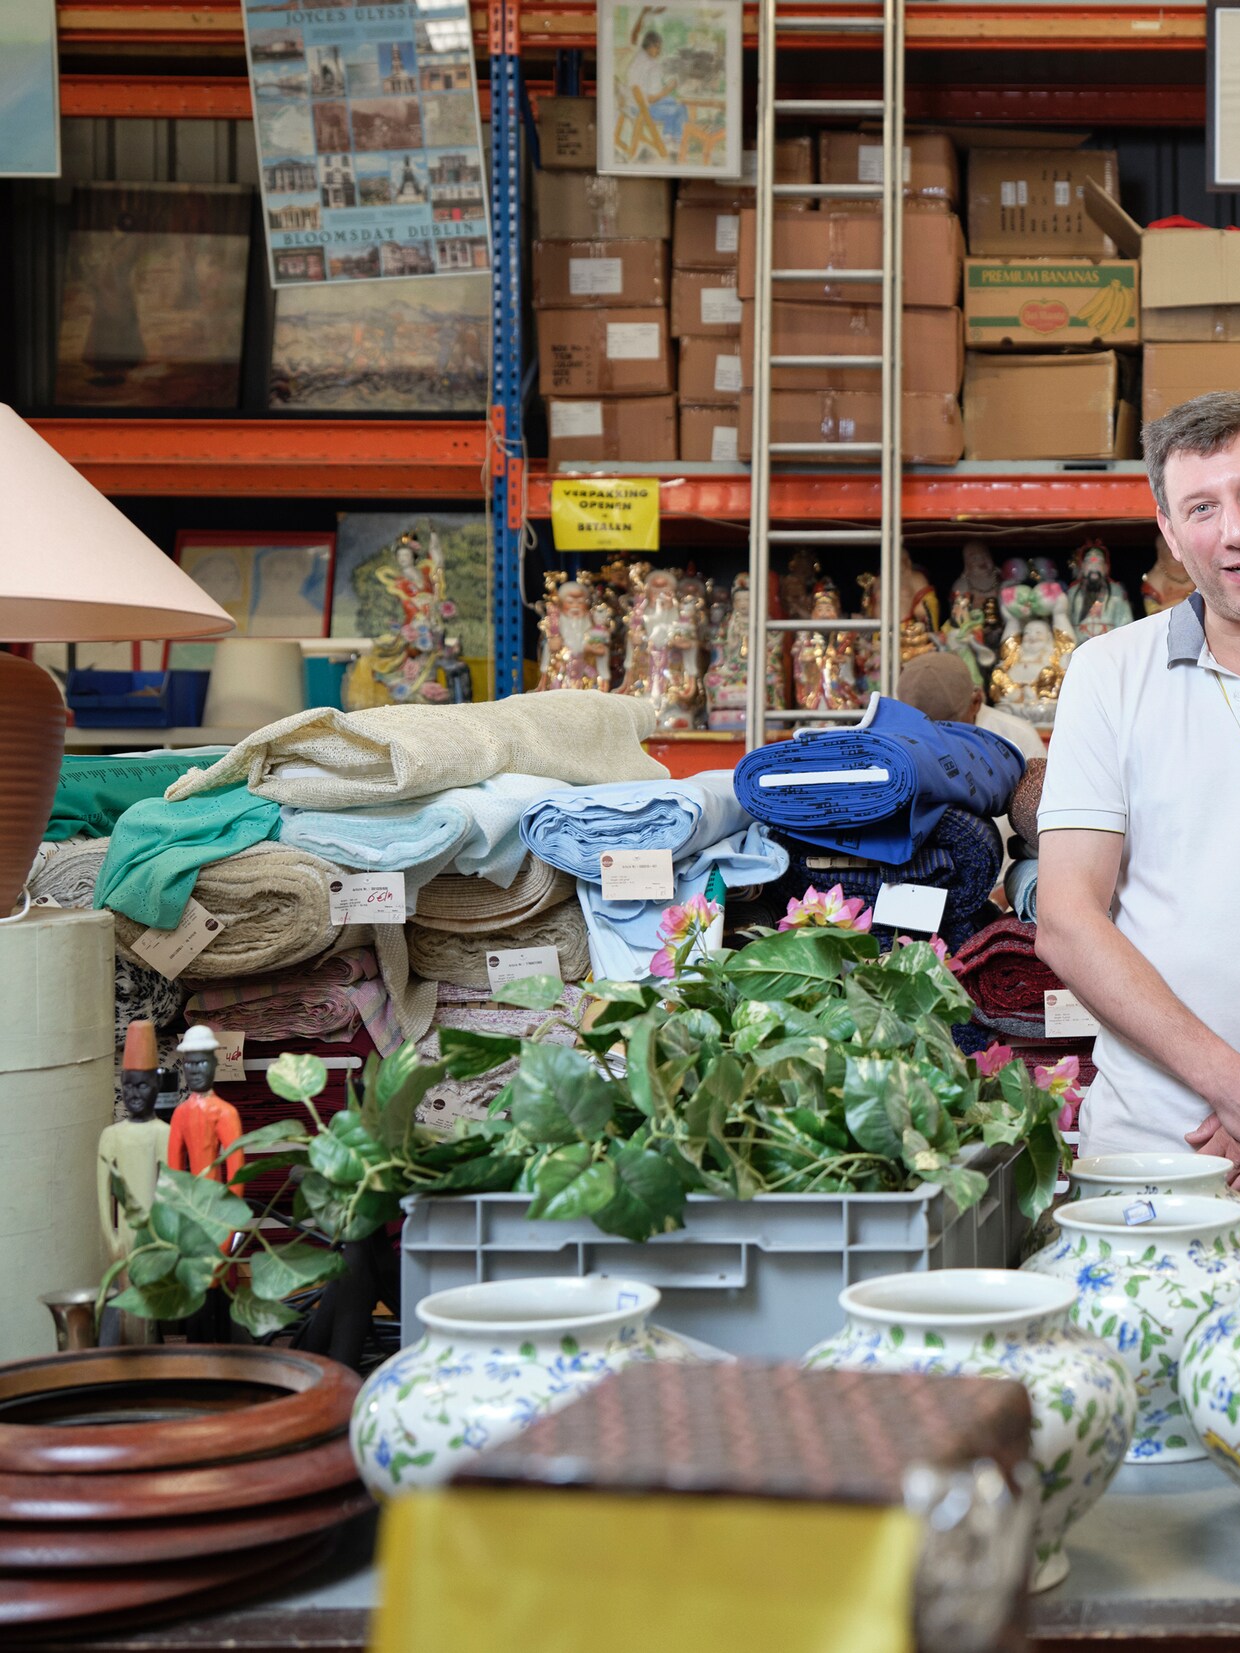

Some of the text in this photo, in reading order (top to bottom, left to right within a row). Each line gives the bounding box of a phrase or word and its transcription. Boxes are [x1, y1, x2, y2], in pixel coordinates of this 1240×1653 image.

[283, 221, 475, 245] BLOOMSDAY DUBLIN
[982, 270, 1099, 283] PREMIUM BANANAS
[563, 489, 648, 498] VERPAKKING
[579, 501, 632, 510] OPENEN
[577, 522, 632, 531] BETALEN
